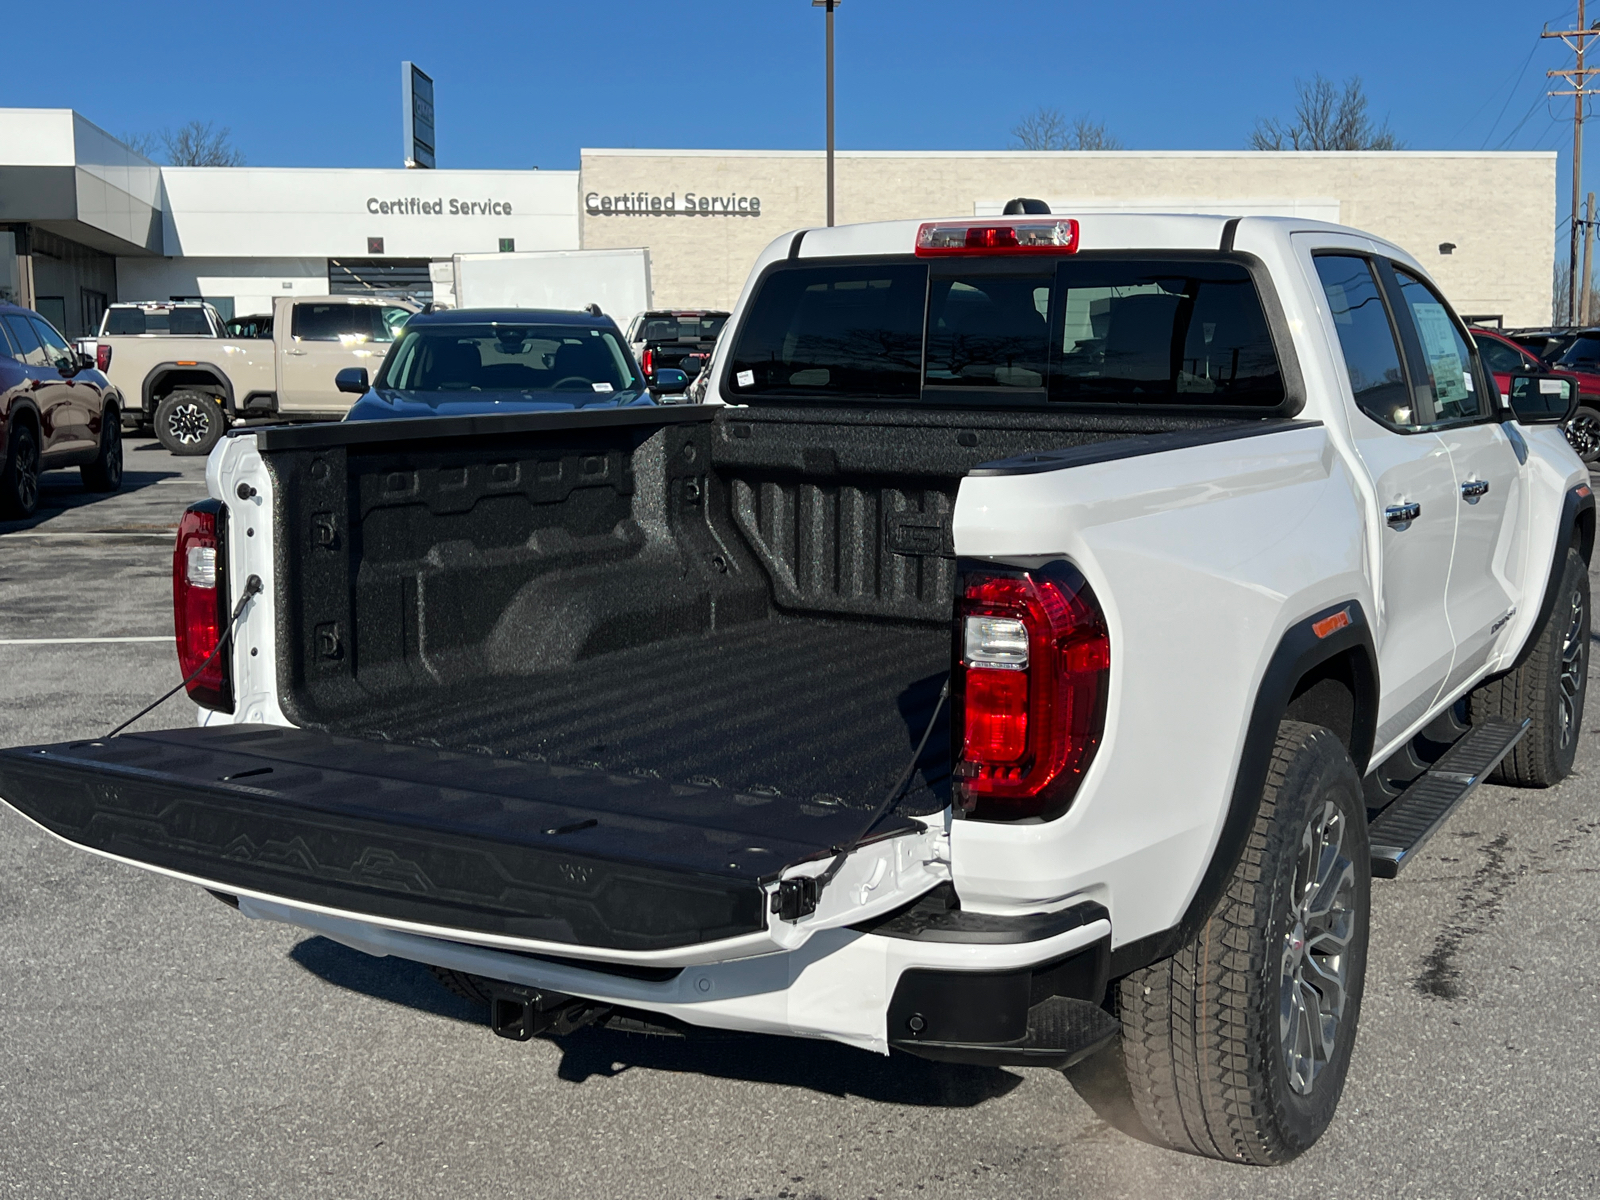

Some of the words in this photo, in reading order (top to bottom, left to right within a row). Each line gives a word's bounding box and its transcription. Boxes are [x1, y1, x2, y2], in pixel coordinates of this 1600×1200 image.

[366, 197, 443, 215] Certified
[449, 198, 512, 216] Service
[585, 192, 676, 214] Certified
[684, 192, 761, 214] Service
